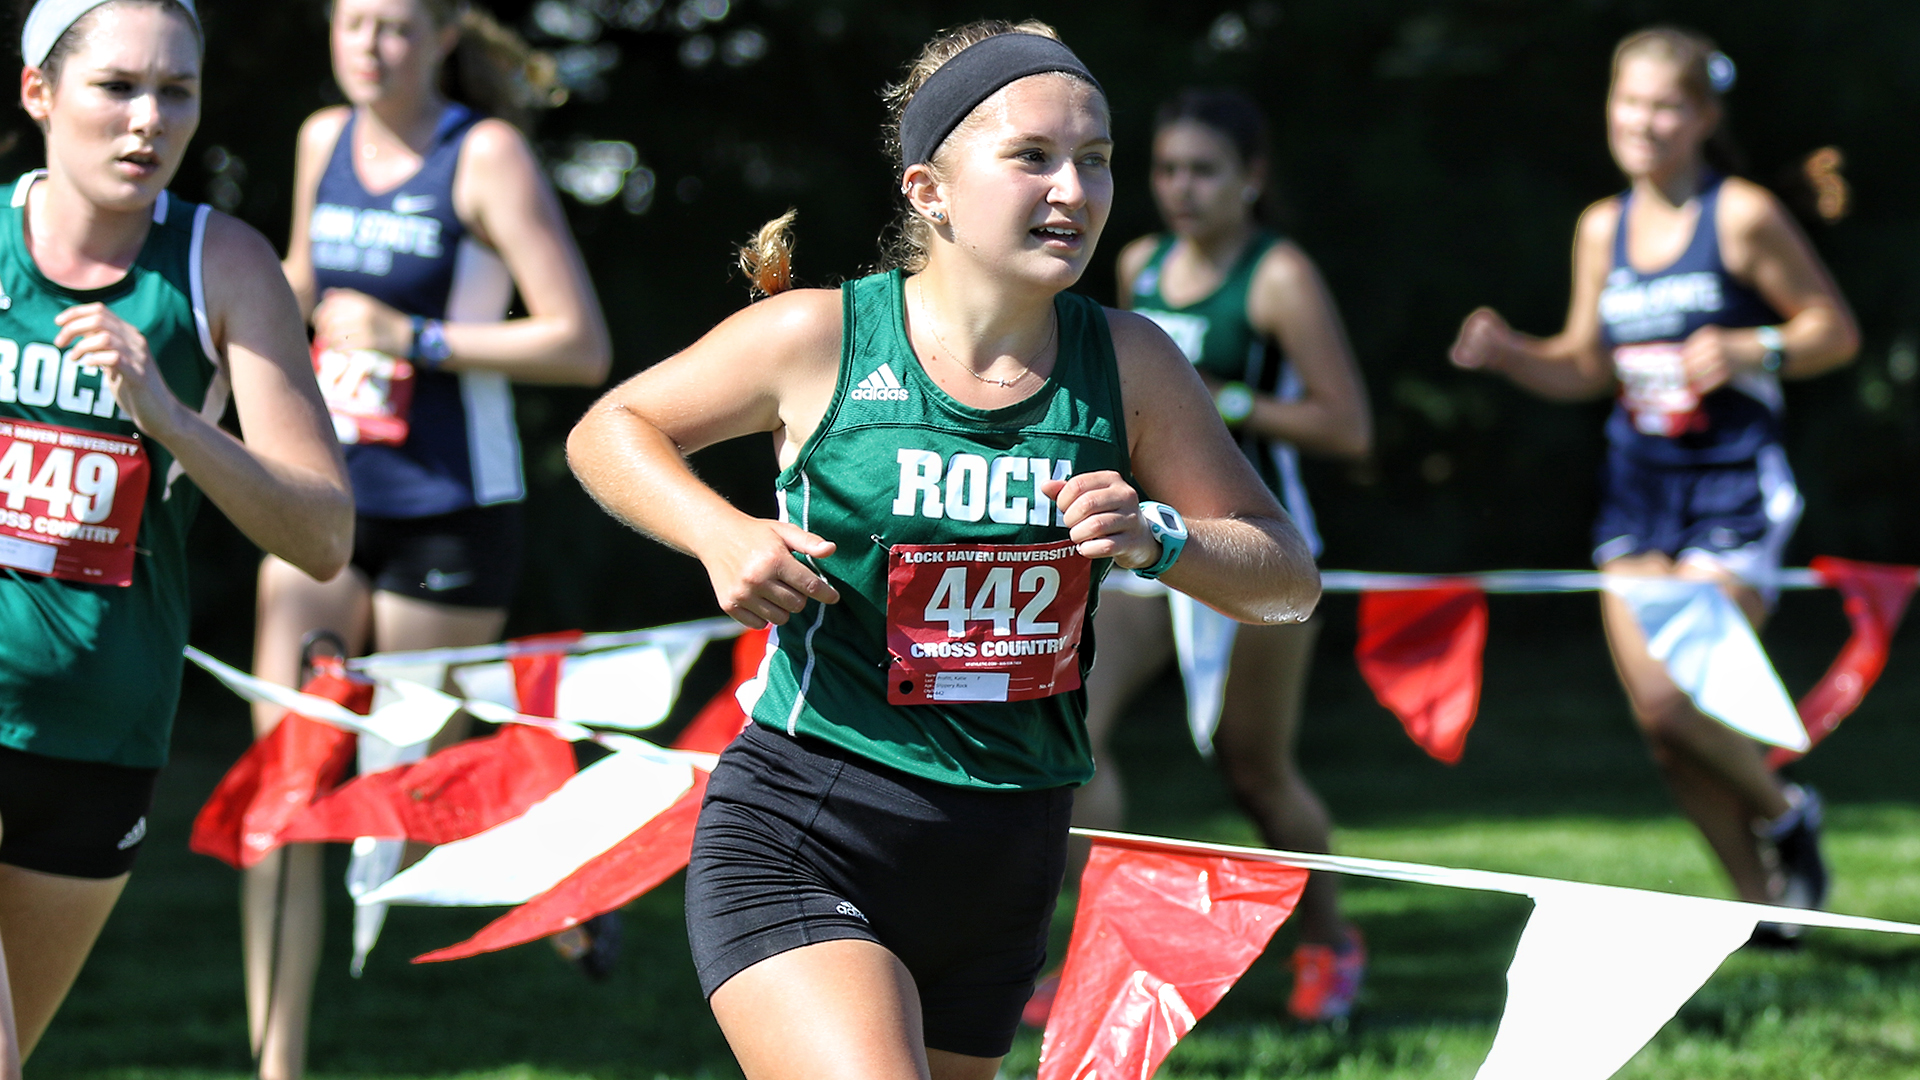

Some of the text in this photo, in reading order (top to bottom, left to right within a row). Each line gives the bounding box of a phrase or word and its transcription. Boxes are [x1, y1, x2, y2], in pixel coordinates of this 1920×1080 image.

[851, 387, 909, 401] adidas
[58, 432, 138, 456] UNIVERSITY
[0, 440, 119, 524] 449
[34, 516, 120, 544] COUNTRY
[904, 545, 1077, 564] LOCK HAVEN UNIVERSITY
[924, 565, 1061, 638] 442
[910, 637, 1065, 658] CROSS COUNTRY
